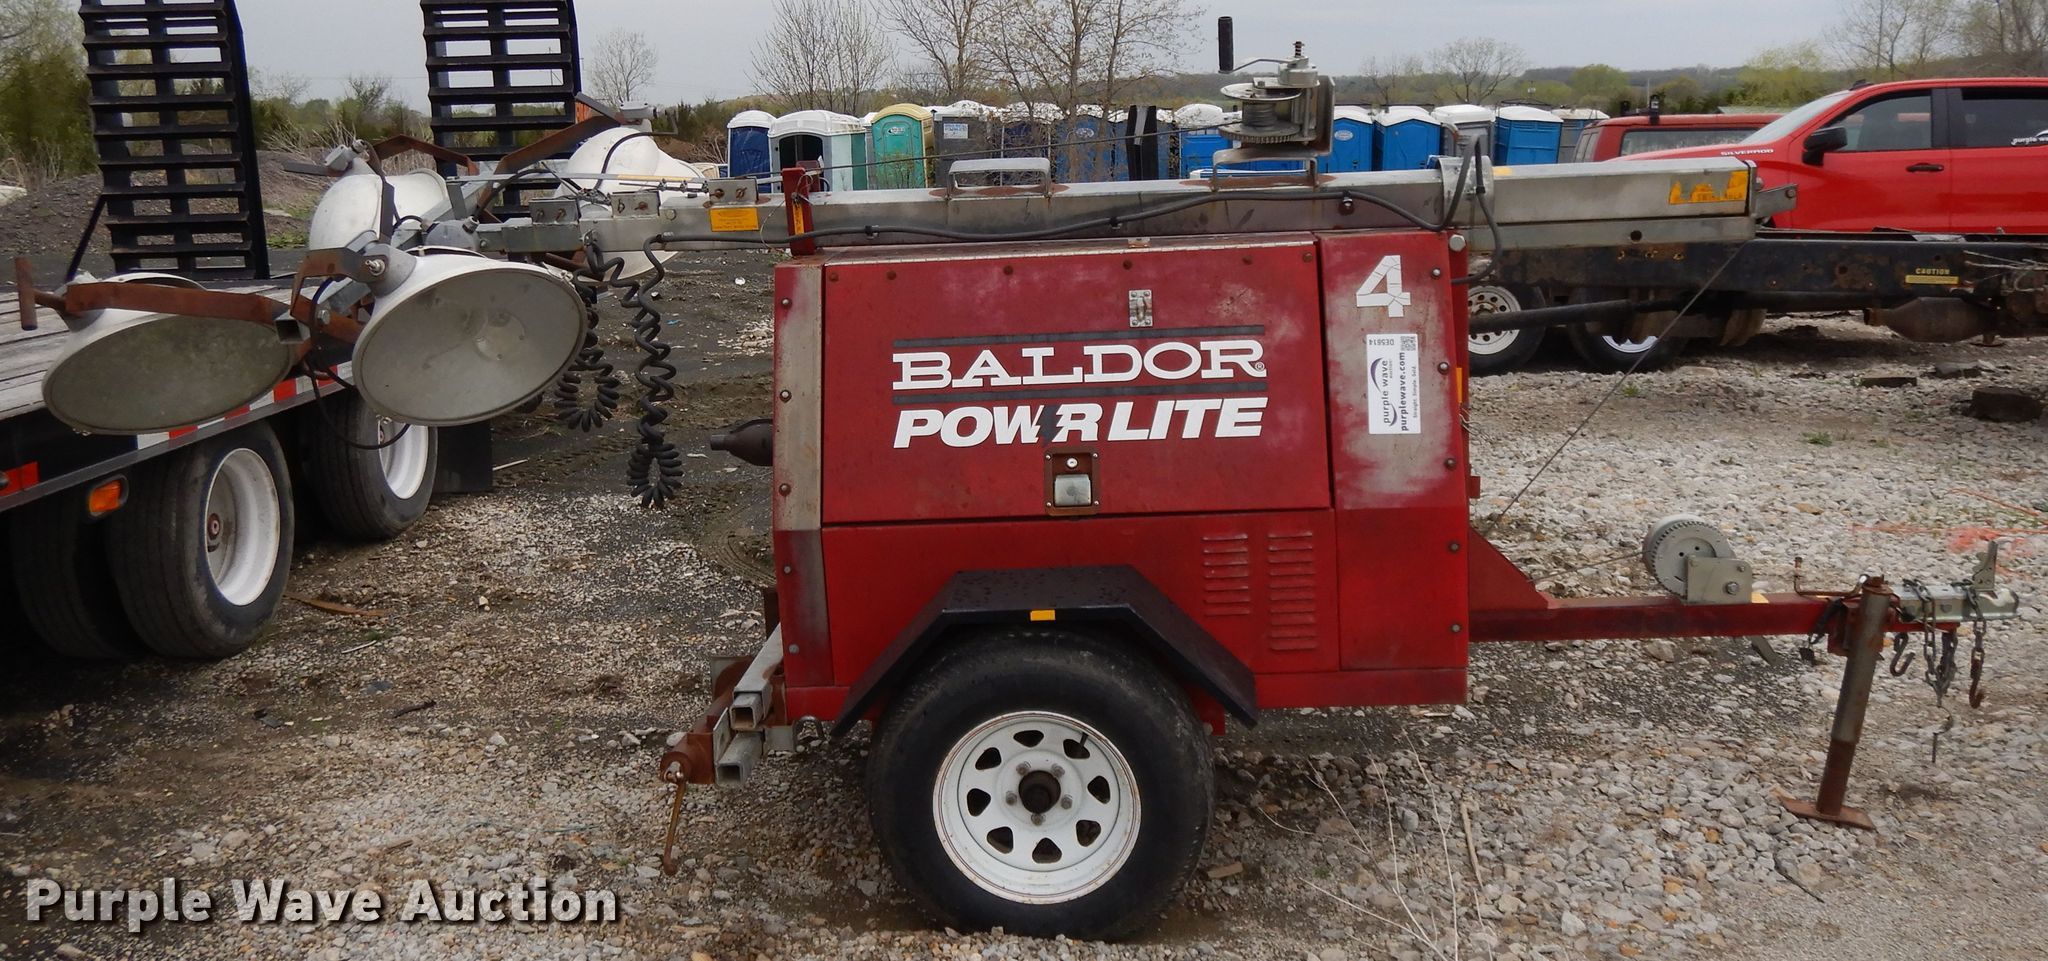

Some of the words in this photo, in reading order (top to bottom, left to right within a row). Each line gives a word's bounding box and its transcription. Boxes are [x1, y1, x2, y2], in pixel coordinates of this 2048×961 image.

[1356, 255, 1412, 318] 4
[1915, 267, 1951, 275] CAUTION
[1381, 360, 1389, 388] wave
[1382, 390, 1391, 424] purple
[1399, 352, 1409, 432] purplewave.com
